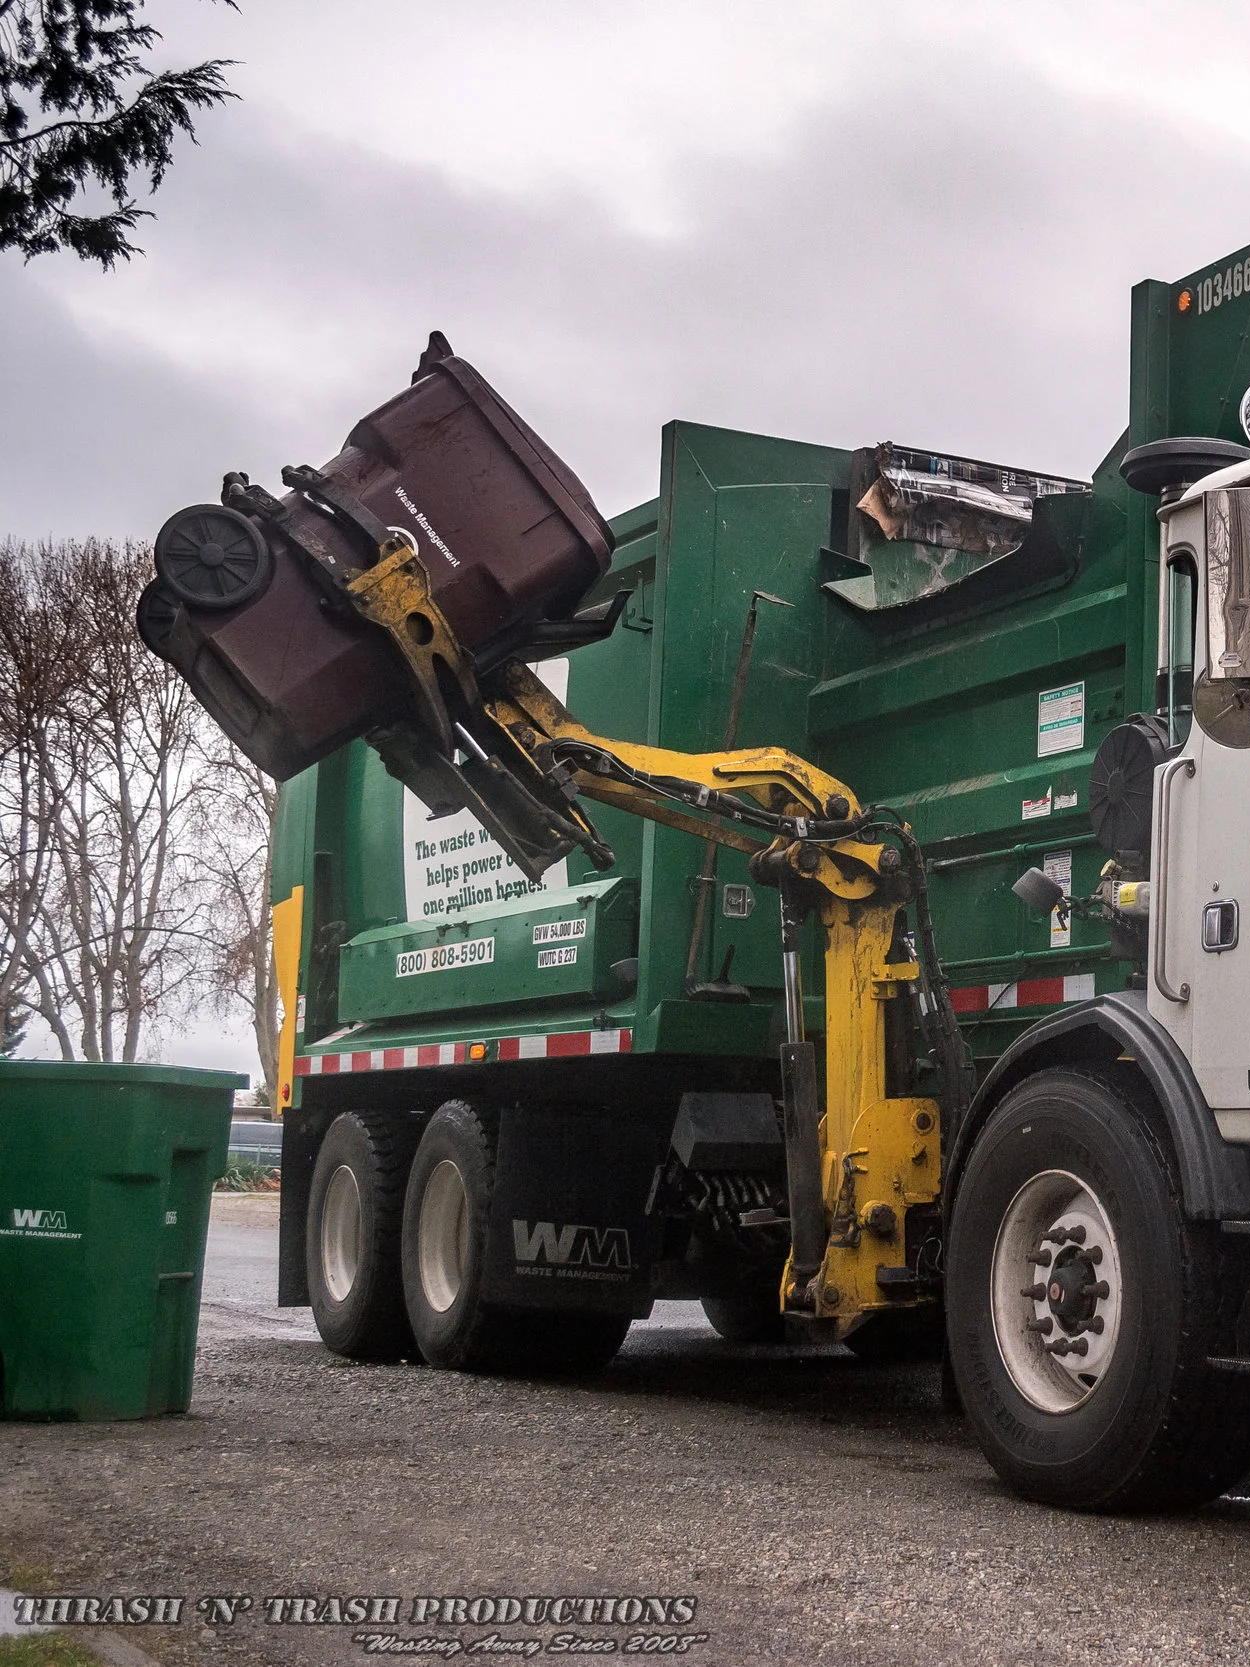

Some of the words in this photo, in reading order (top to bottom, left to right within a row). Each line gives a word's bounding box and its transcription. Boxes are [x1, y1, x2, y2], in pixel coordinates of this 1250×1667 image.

[394, 486, 418, 515] Waste
[414, 512, 461, 568] Management
[415, 841, 437, 861] The
[439, 829, 475, 854] waste
[426, 863, 459, 888] helps
[463, 854, 503, 884] power
[423, 898, 445, 916] one
[446, 884, 493, 913] million
[495, 879, 548, 900] homes.
[534, 925, 549, 941] GVW
[550, 924, 572, 939] 54,000
[572, 922, 585, 937] LBS
[396, 952, 427, 976] (800)
[431, 939, 494, 969] 808-5901
[539, 951, 557, 967] WUTC
[557, 950, 563, 964] G
[563, 948, 577, 963] 237
[13, 1208, 68, 1230] WM
[25, 1230, 83, 1240] MANAGEMENT
[512, 1219, 632, 1269] WM
[515, 1265, 553, 1277] WASTE
[556, 1268, 631, 1282] MANAGEMENT
